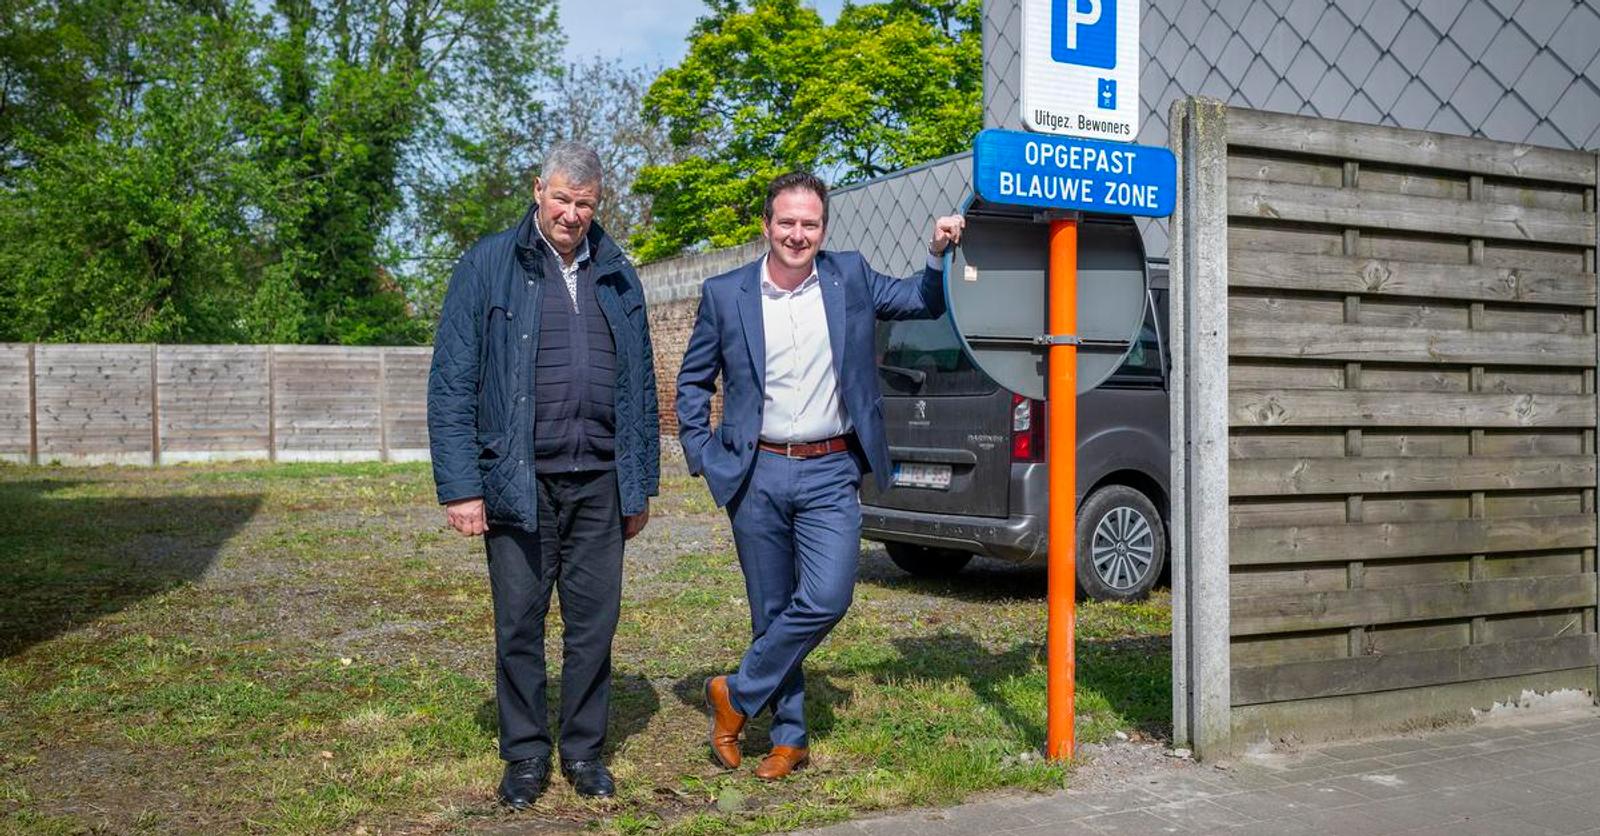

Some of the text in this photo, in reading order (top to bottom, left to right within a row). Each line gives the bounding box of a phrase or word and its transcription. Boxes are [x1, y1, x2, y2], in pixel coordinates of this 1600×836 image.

[1066, 0, 1102, 50] P
[1035, 110, 1130, 135] Uitgez. Bewoners
[1025, 141, 1136, 174] OPGEPAST
[1000, 172, 1159, 208] BLAUWE ZONE
